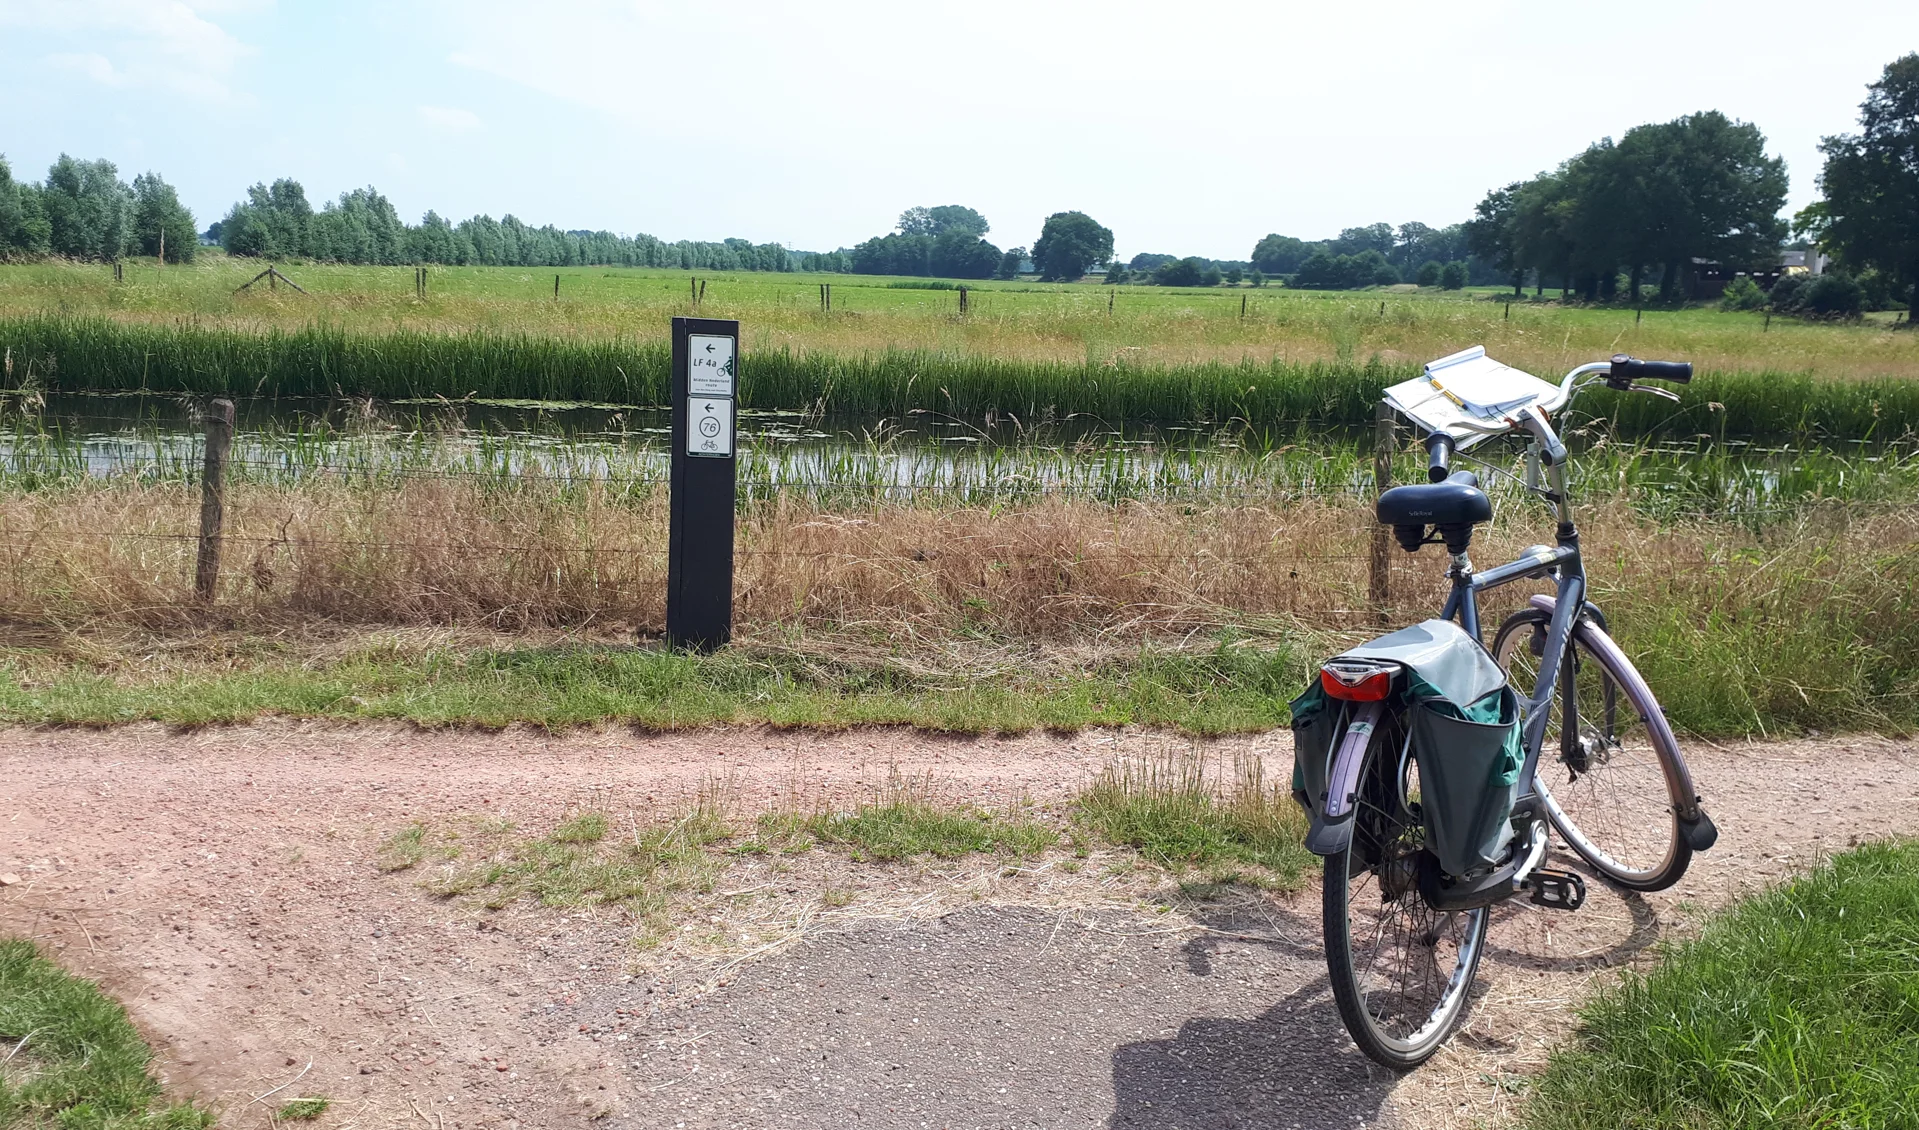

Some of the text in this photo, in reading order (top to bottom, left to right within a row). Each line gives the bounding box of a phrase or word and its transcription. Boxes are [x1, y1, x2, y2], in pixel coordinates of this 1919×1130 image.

[693, 358, 717, 367] LF 4a
[703, 422, 717, 432] 76
